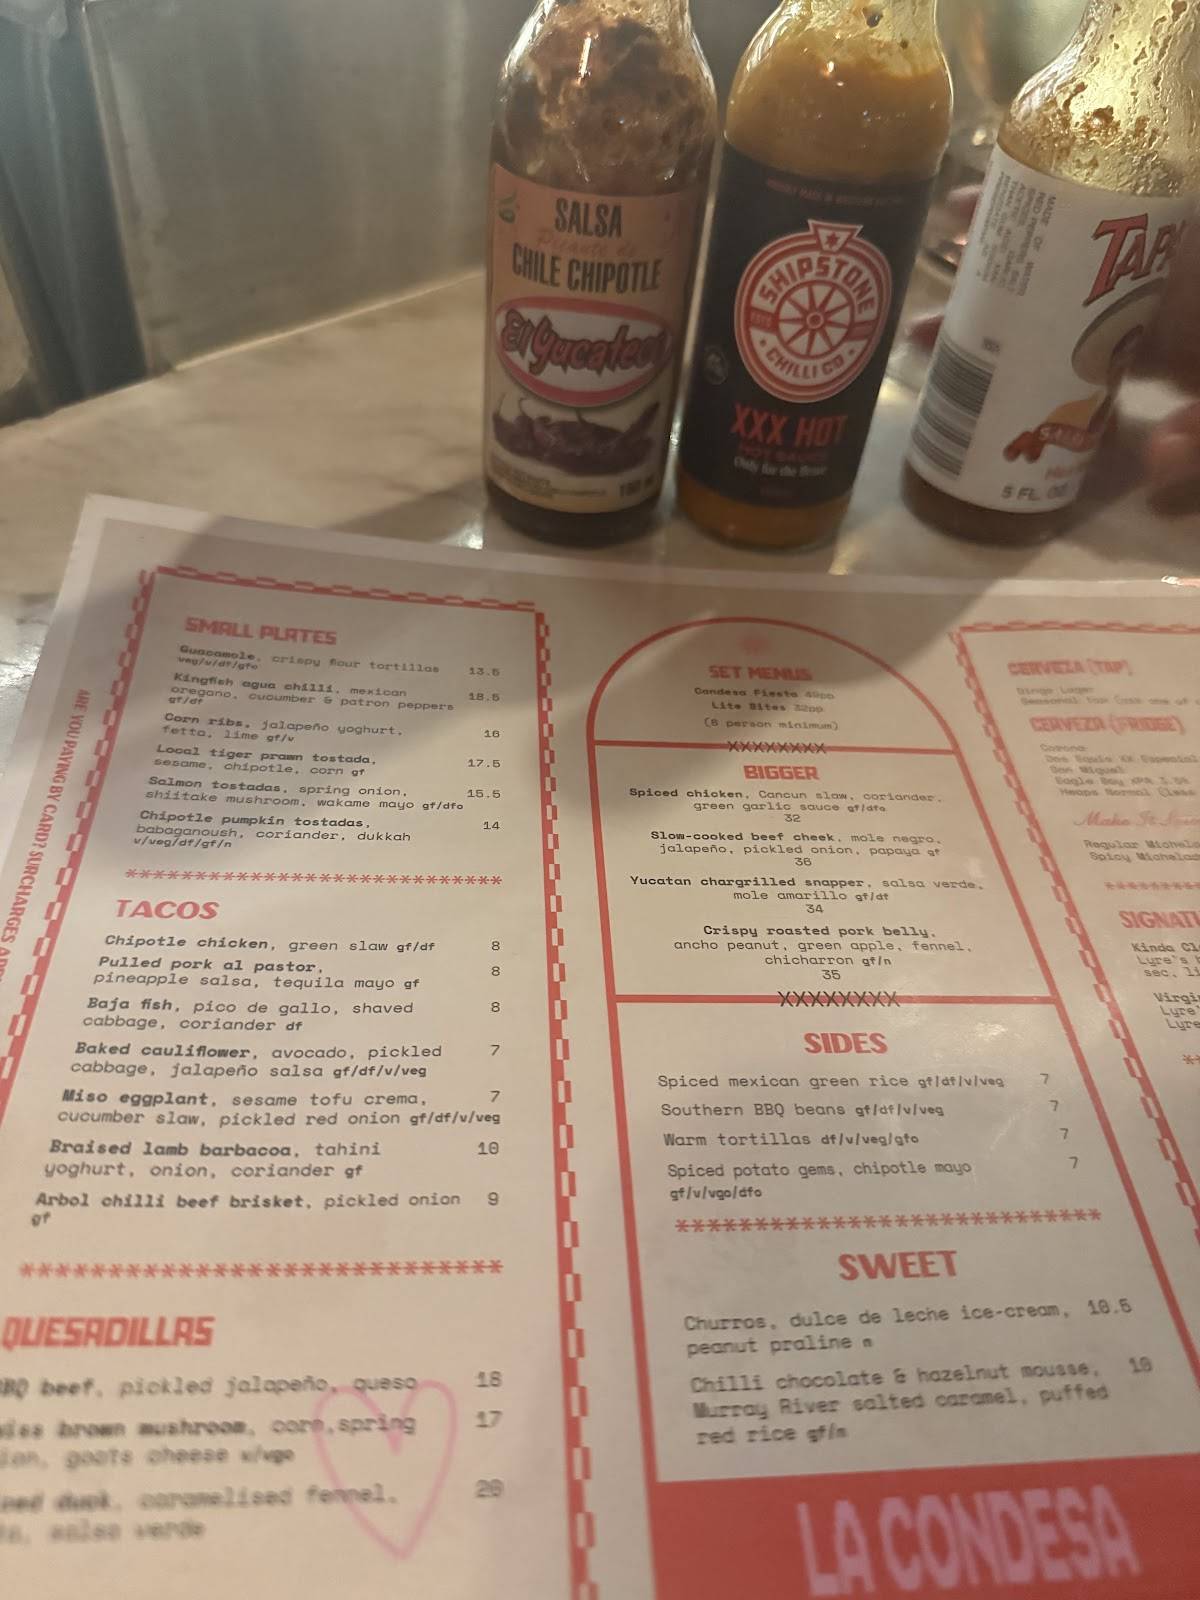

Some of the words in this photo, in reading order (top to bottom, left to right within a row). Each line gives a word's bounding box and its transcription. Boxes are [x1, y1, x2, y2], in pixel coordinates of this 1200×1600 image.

[554, 197, 622, 238] SALSA
[512, 244, 560, 288] CHILE
[567, 259, 663, 293] CHIPOTLE
[758, 256, 878, 318] SHIPSTONE
[765, 349, 818, 383] CHILLI
[730, 402, 789, 445] XXX
[794, 413, 849, 448] HOT
[184, 616, 254, 639] SMALL
[259, 624, 338, 645] PLATES
[74, 688, 90, 712] ARE
[66, 715, 85, 738] YOU
[52, 739, 78, 784] PAYING
[157, 744, 200, 756] Local
[210, 748, 252, 759] tiger
[261, 752, 303, 762] prawn
[468, 759, 501, 768] 17.5
[743, 765, 820, 781] BIGGER
[46, 785, 64, 802] BY
[148, 776, 202, 788] Salmon
[299, 784, 350, 797] spring
[467, 789, 501, 799] 15.5
[145, 789, 217, 802] shiitake
[317, 798, 370, 808] wakame
[379, 799, 414, 811] mayo
[422, 801, 463, 811] gf/dfo
[32, 804, 58, 848] CARD?
[140, 810, 213, 823] Chipotle
[221, 815, 285, 827] pumpkin
[294, 816, 370, 829] tostadas,
[483, 821, 500, 830] 14
[785, 814, 801, 823] 32
[134, 837, 232, 849] v/veg/df/gf/n
[255, 827, 345, 842] coriander,
[357, 830, 411, 841] dukkah
[630, 876, 692, 886] Yucatan
[701, 877, 796, 888] chargrilled
[805, 878, 872, 888] snapper,
[882, 879, 925, 888] salsa
[1, 850, 45, 943] SURCHARGES
[733, 891, 769, 900] mole
[777, 891, 847, 901] amarillo
[855, 893, 889, 902] gf/df
[115, 899, 221, 920] TACOS
[806, 904, 824, 914] 34
[703, 925, 758, 937] Crispy
[767, 926, 829, 936] roasted
[839, 927, 874, 937] pork
[883, 927, 936, 938] belly,
[104, 934, 187, 949] Chipotle
[197, 937, 277, 951] chicken,
[288, 939, 338, 953] green
[348, 940, 388, 952] slaw
[396, 940, 436, 953] gf/df
[491, 940, 501, 951] 8
[765, 954, 853, 966] chicharron
[862, 957, 892, 967] gf/n
[491, 965, 501, 977] 8
[822, 970, 841, 980] 35
[75, 1042, 132, 1056] Baked
[141, 1042, 259, 1060] cauliflower,
[272, 1045, 355, 1060] avocado,
[368, 1045, 443, 1059] pickled
[490, 1044, 501, 1057] 7
[803, 1032, 889, 1054] SIDES
[71, 1061, 156, 1078] cabbage,
[170, 1064, 259, 1079] jalapeño
[270, 1065, 324, 1078] salsa
[333, 1065, 428, 1079] gf/df/v/veg
[657, 1075, 719, 1089] Spiced
[728, 1076, 799, 1087] mexican
[809, 1076, 859, 1090] green
[869, 1075, 909, 1087] rice
[918, 1076, 1005, 1088] gf/df/v/veg
[1040, 1073, 1049, 1085] 7
[661, 1103, 744, 1116] Southern
[753, 1103, 785, 1118] BBQ
[794, 1103, 846, 1116] beans
[855, 1104, 944, 1117] gf/df/v/veg
[1049, 1099, 1059, 1111] 7
[58, 1110, 145, 1125] cucumber
[155, 1111, 207, 1127] slaw,
[219, 1112, 296, 1128] pickled
[306, 1113, 337, 1126] red
[347, 1112, 401, 1125] onion
[409, 1111, 501, 1126] gf/df/v/veg
[49, 1139, 132, 1156] Braised
[143, 1142, 189, 1156] lamb
[199, 1142, 301, 1159] barbacoa,
[315, 1142, 381, 1156] tahini
[477, 1141, 500, 1156] 10
[667, 1164, 724, 1179] Spiced
[733, 1164, 790, 1180] potato
[798, 1165, 844, 1179] gems,
[853, 1161, 927, 1176] chipotle
[935, 1163, 973, 1176] mayo
[1069, 1156, 1079, 1170] 7
[36, 1193, 89, 1208] Arbol
[101, 1193, 165, 1208] chilli
[177, 1195, 219, 1208] beef
[229, 1194, 313, 1210] brisket,
[324, 1194, 404, 1210] pickled
[409, 1193, 460, 1207] onion
[487, 1192, 499, 1206] 9
[838, 1249, 957, 1281] SWEET
[790, 1312, 848, 1328] dulce
[858, 1310, 882, 1325] de
[894, 1307, 950, 1323] leche
[1, 1315, 216, 1351] QUESADILLAS
[693, 1401, 768, 1420] Murray
[779, 1398, 841, 1415] River
[853, 1395, 920, 1412] salted
[1039, 1384, 1110, 1406] puffed
[796, 1499, 874, 1598] LA
[878, 1483, 1142, 1591] CONDESA
